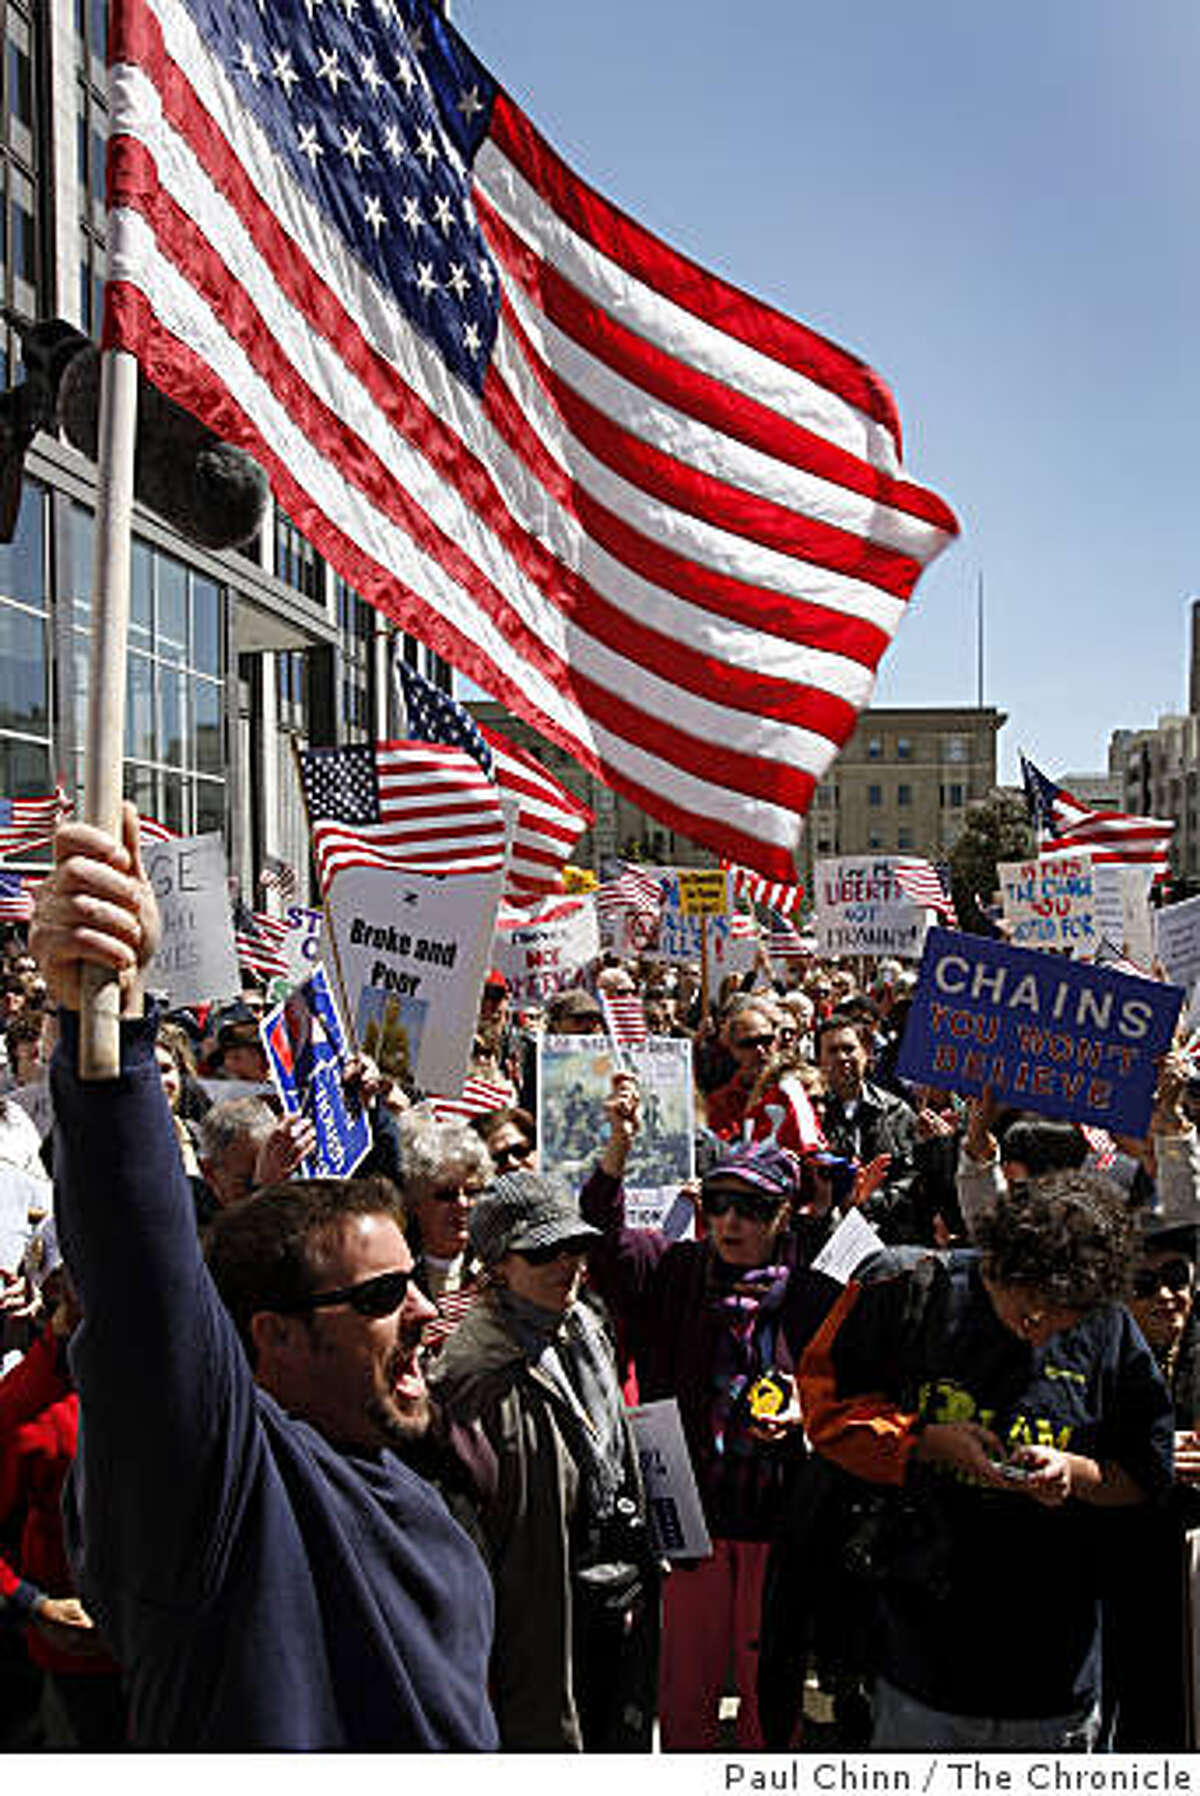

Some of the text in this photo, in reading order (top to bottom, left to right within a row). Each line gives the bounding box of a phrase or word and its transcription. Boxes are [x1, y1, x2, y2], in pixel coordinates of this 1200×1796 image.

[350, 918, 457, 969] Broke and
[370, 960, 421, 997] Poor
[935, 955, 1153, 1038] CHAINS
[930, 1002, 998, 1044] YOU
[932, 1044, 1112, 1110] BELIEVE
